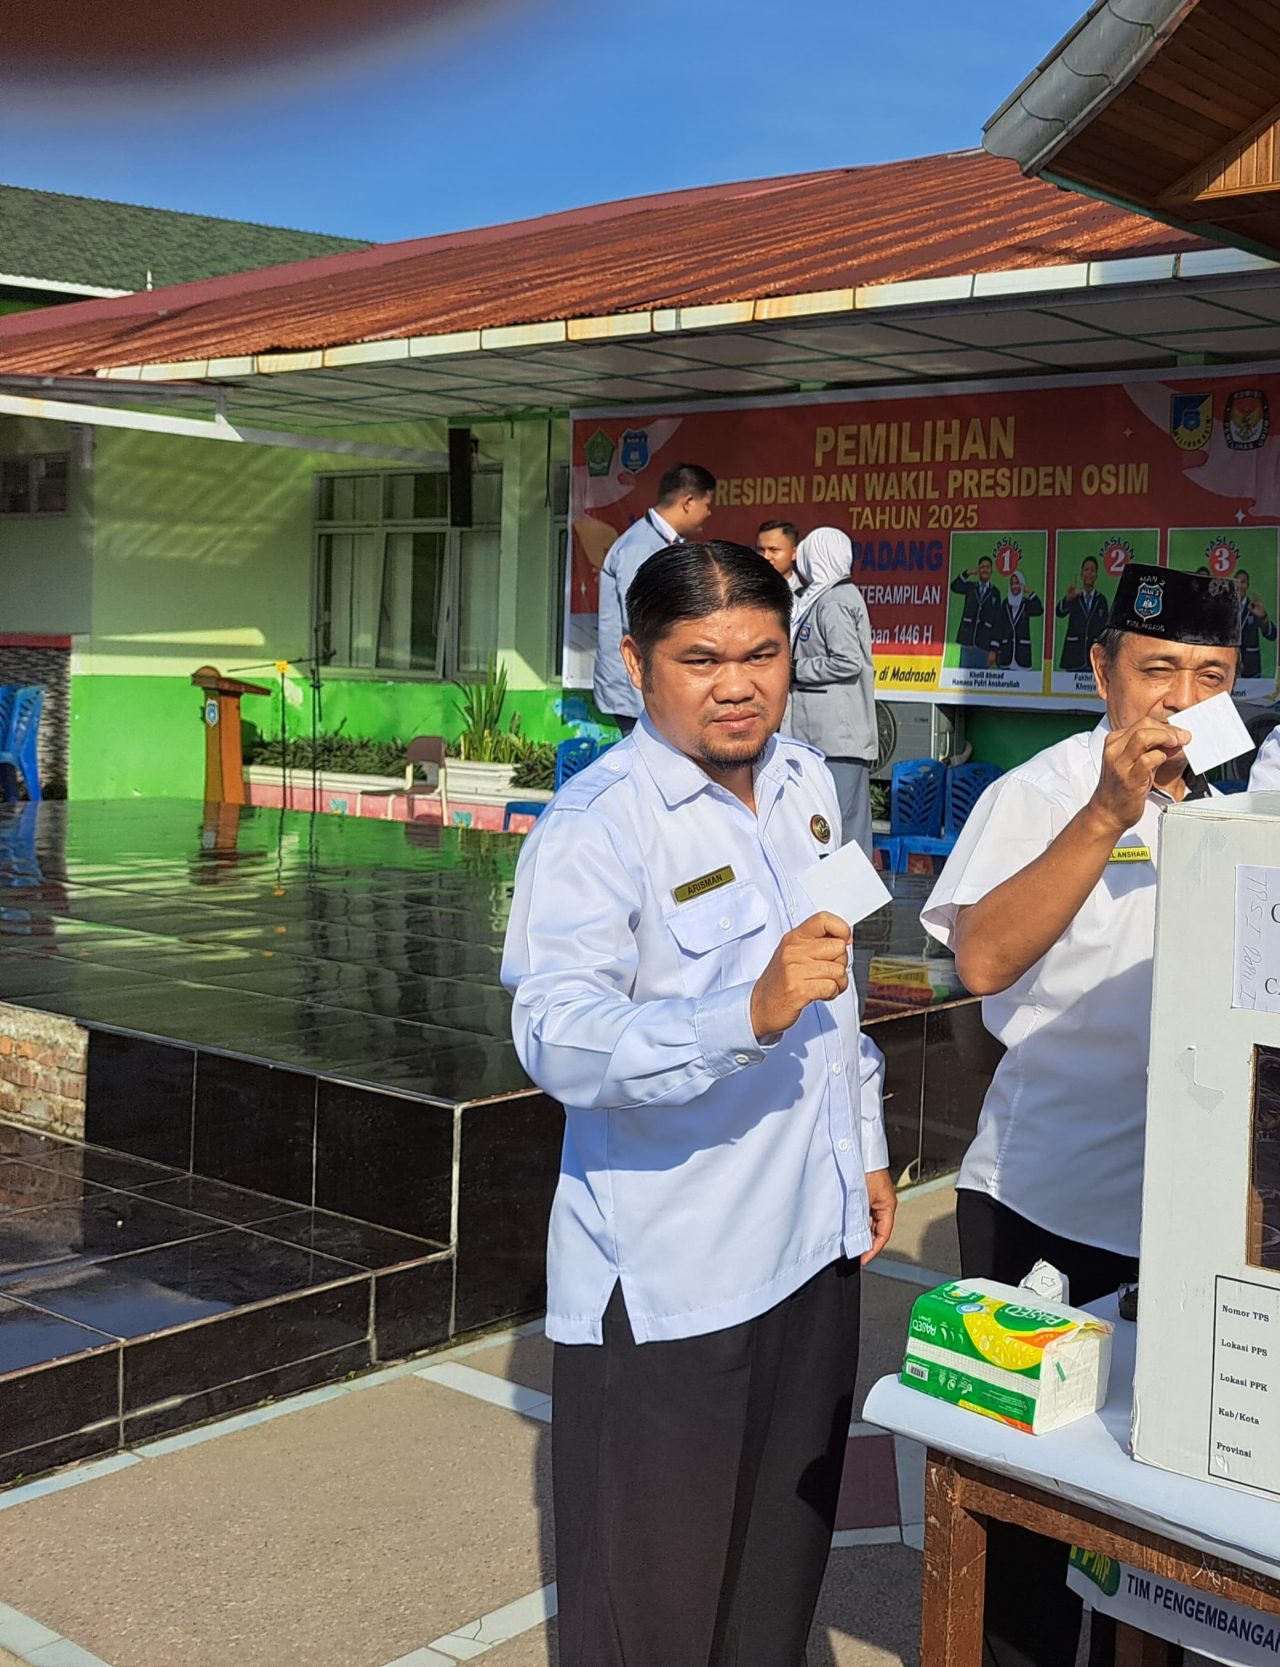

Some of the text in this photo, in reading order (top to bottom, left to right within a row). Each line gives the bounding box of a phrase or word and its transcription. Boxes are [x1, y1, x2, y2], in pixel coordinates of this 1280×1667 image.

[814, 416, 1016, 467] PEMILIHAN
[714, 463, 1150, 506] RESIDEN DAN WAKIL PRESIDEN OSIM
[849, 504, 979, 531] TAHUN 2025
[1001, 549, 1011, 572] 1
[1110, 548, 1126, 571] 2
[1215, 548, 1230, 571] 3
[894, 625, 920, 645] 1446
[923, 624, 933, 645] H
[879, 665, 890, 682] di
[890, 667, 936, 683] Madrasah
[687, 873, 723, 896] ARISMAN
[1004, 1304, 1065, 1326] PASEO
[1222, 1304, 1250, 1318] Nomor
[1252, 1311, 1270, 1323] TPS
[912, 1318, 937, 1337] PASEO
[1221, 1339, 1249, 1353] Lokasi
[1251, 1346, 1268, 1357] PPS
[1219, 1373, 1248, 1387] Lokasi
[1249, 1380, 1268, 1392] PPK
[1218, 1407, 1260, 1425] Kab/Kota
[1216, 1441, 1252, 1458] Provinsi
[1127, 1573, 1151, 1600] TIM
